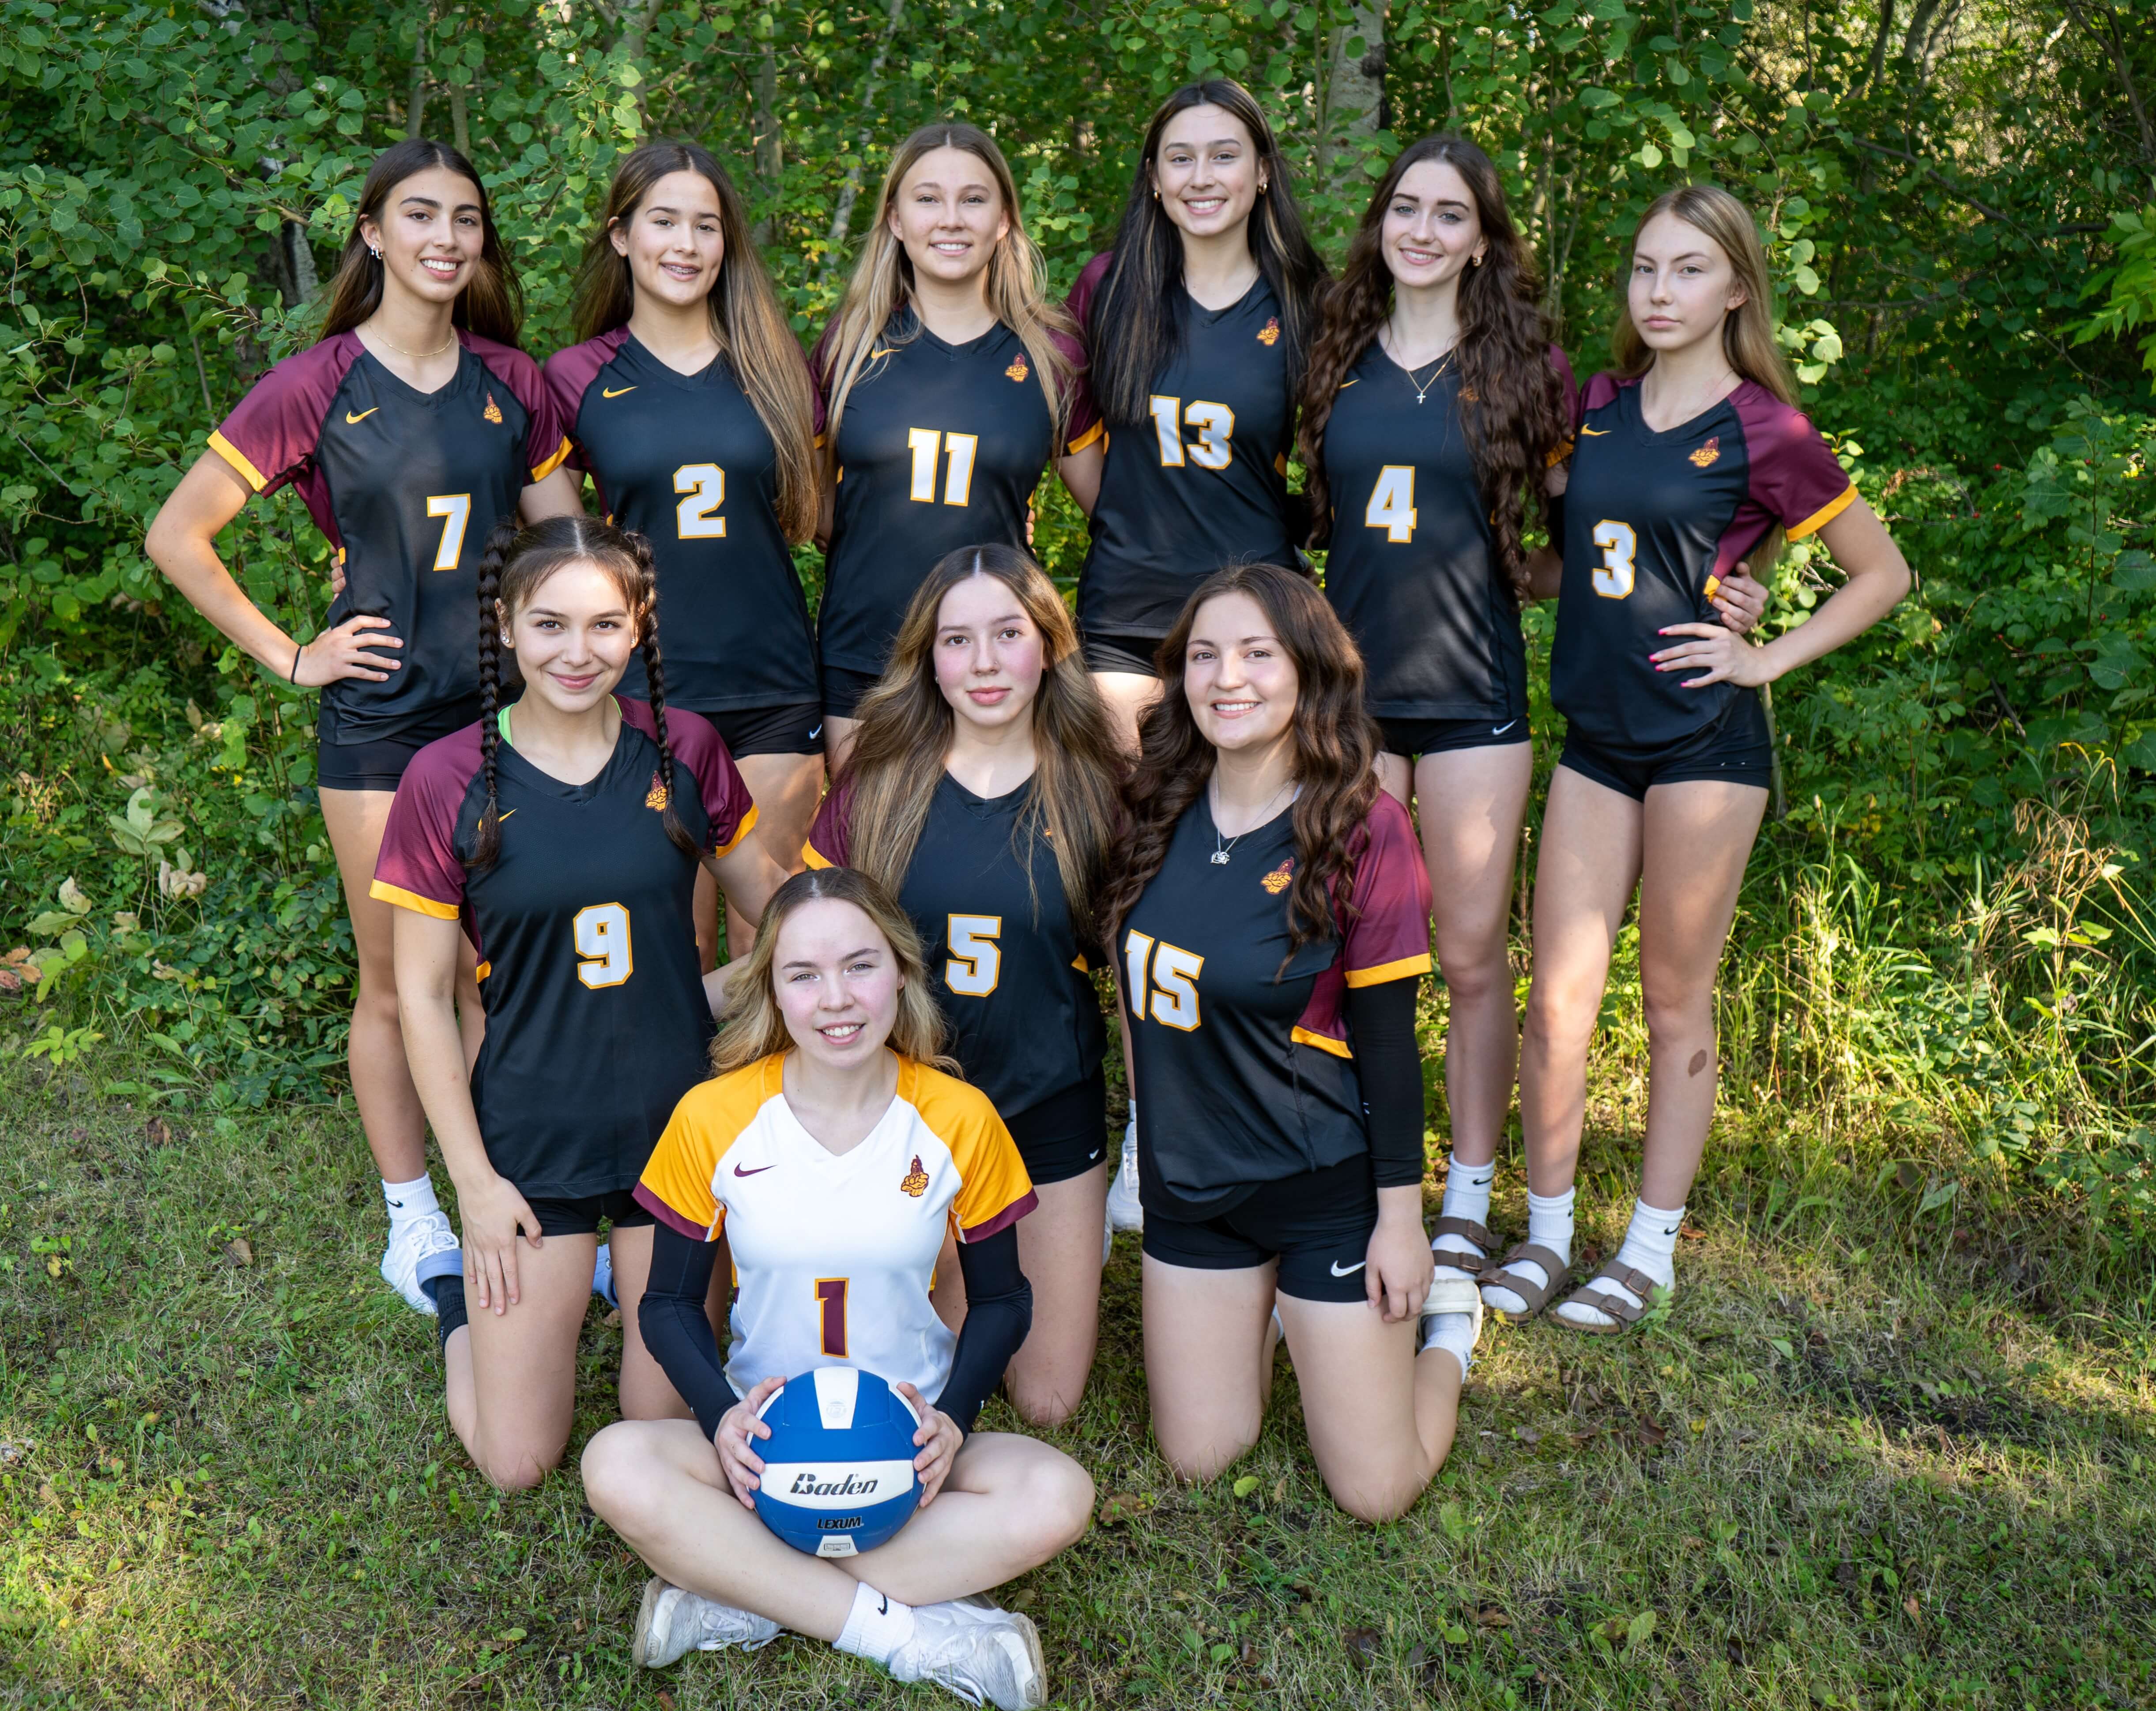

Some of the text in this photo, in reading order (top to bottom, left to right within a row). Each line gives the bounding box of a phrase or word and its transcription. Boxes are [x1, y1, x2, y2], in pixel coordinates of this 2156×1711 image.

[908, 428, 978, 506] 11
[1150, 395, 1235, 469] 13
[427, 493, 471, 571] 7
[673, 463, 726, 539] 2
[1365, 465, 1417, 543] 4
[1592, 519, 1636, 599] 3
[573, 902, 633, 989] 9
[945, 914, 1002, 997] 5
[1124, 929, 1204, 1032] 15
[814, 1278, 849, 1358] 1
[790, 1473, 878, 1496] Baden
[817, 1516, 862, 1530] LEXUM
